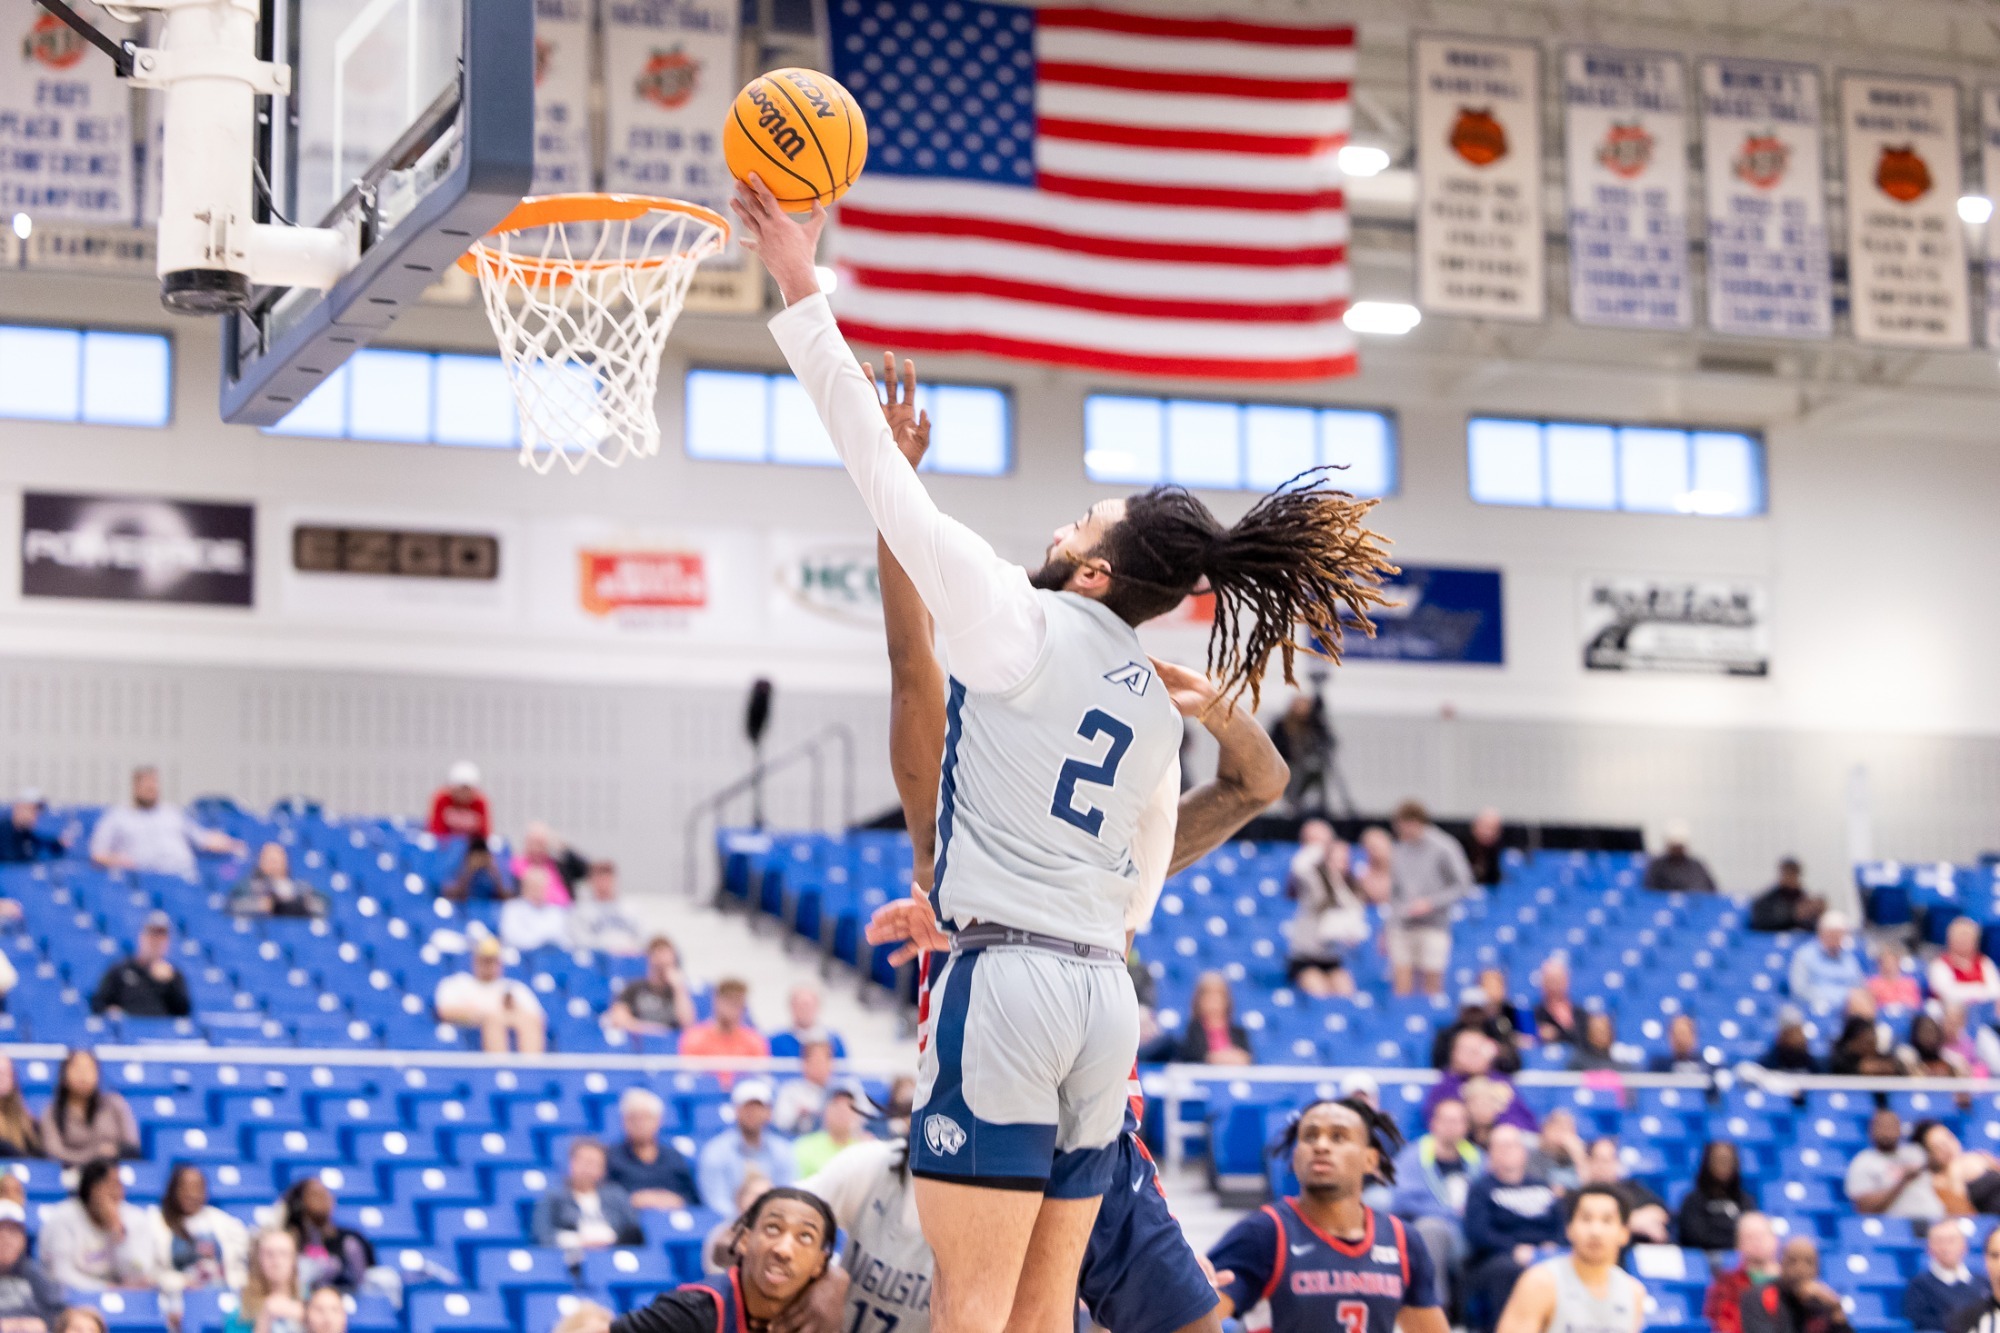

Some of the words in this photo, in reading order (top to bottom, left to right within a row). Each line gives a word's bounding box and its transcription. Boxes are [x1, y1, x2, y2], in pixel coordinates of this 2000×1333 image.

[785, 72, 836, 118] NCAA
[747, 83, 806, 162] Wilson
[1101, 660, 1151, 697] A
[1048, 704, 1136, 841] 2
[848, 1299, 901, 1333] 17
